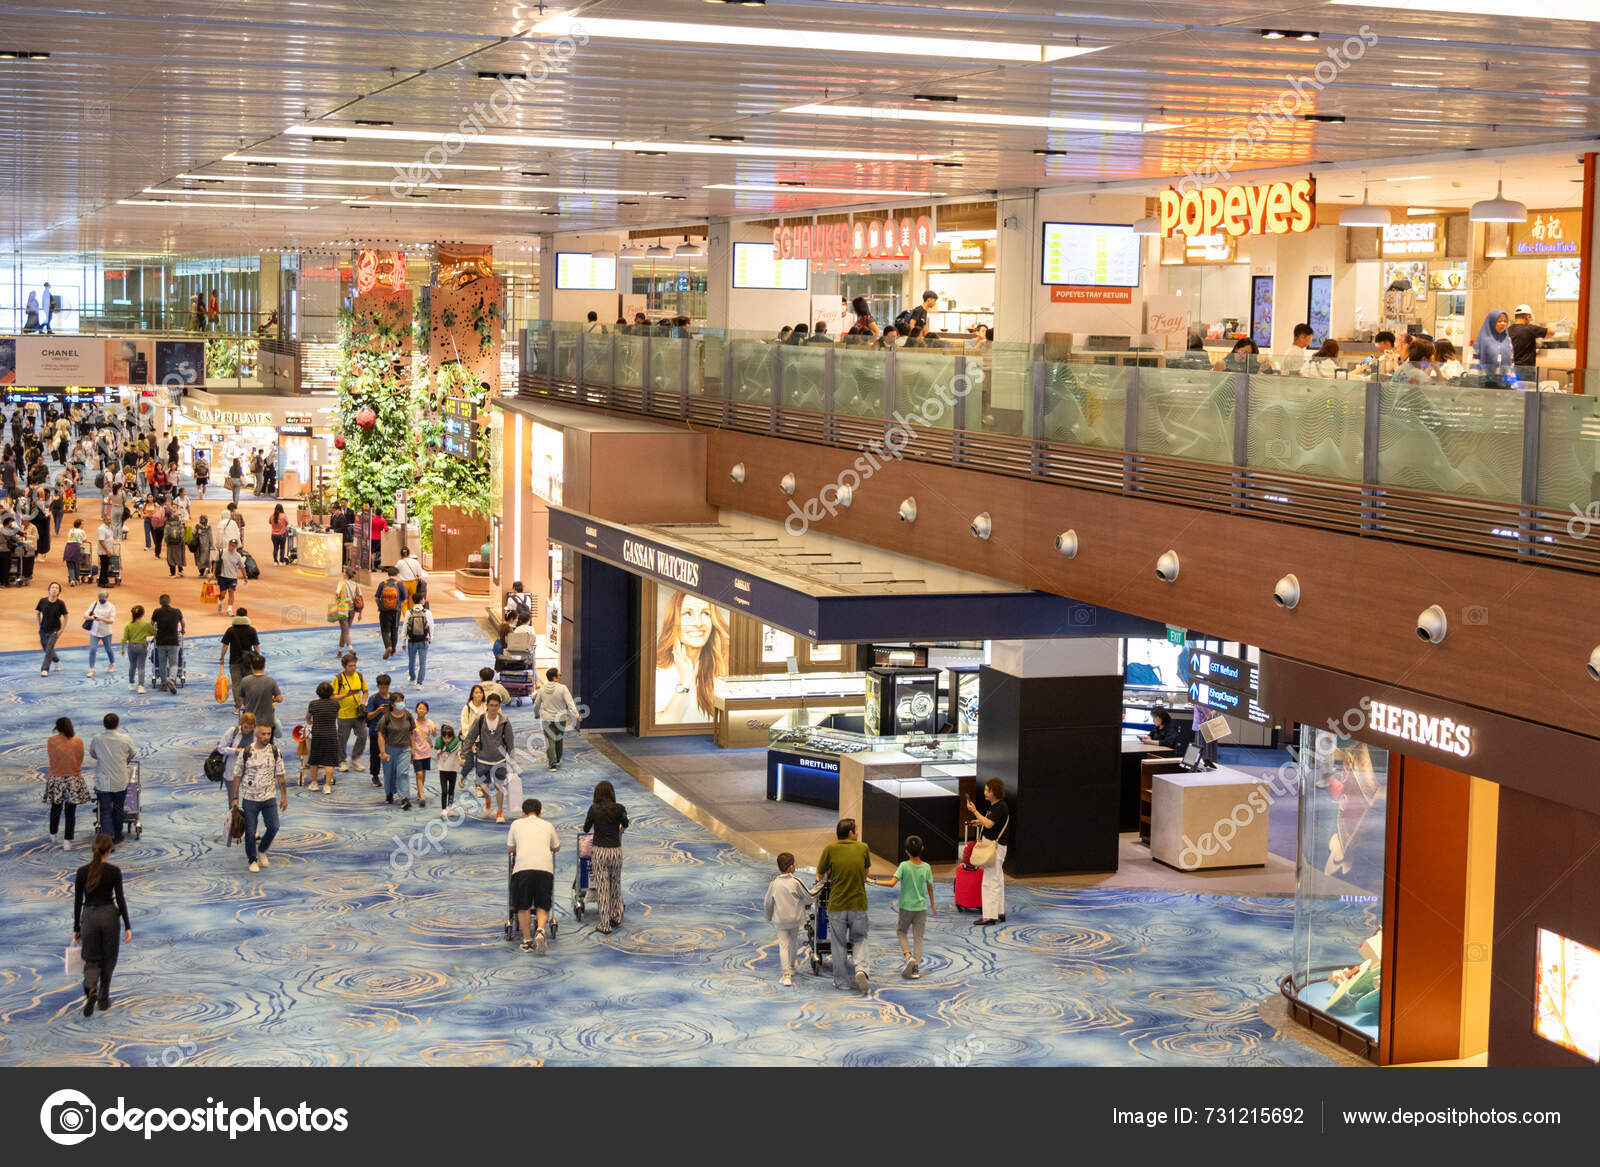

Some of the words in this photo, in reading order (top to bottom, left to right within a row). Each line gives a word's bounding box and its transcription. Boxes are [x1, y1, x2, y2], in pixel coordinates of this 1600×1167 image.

[1383, 222, 1436, 241] DESSERT
[1151, 313, 1185, 331] Tray
[41, 349, 79, 357] CHANEL
[214, 409, 272, 425] PERFUMES
[623, 539, 655, 573] GASSAN
[657, 550, 699, 587] WATCHES
[1170, 630, 1182, 643] EXIT
[1210, 662, 1220, 673] GST
[1220, 663, 1239, 678] Refund
[800, 758, 838, 771] BREITLING
